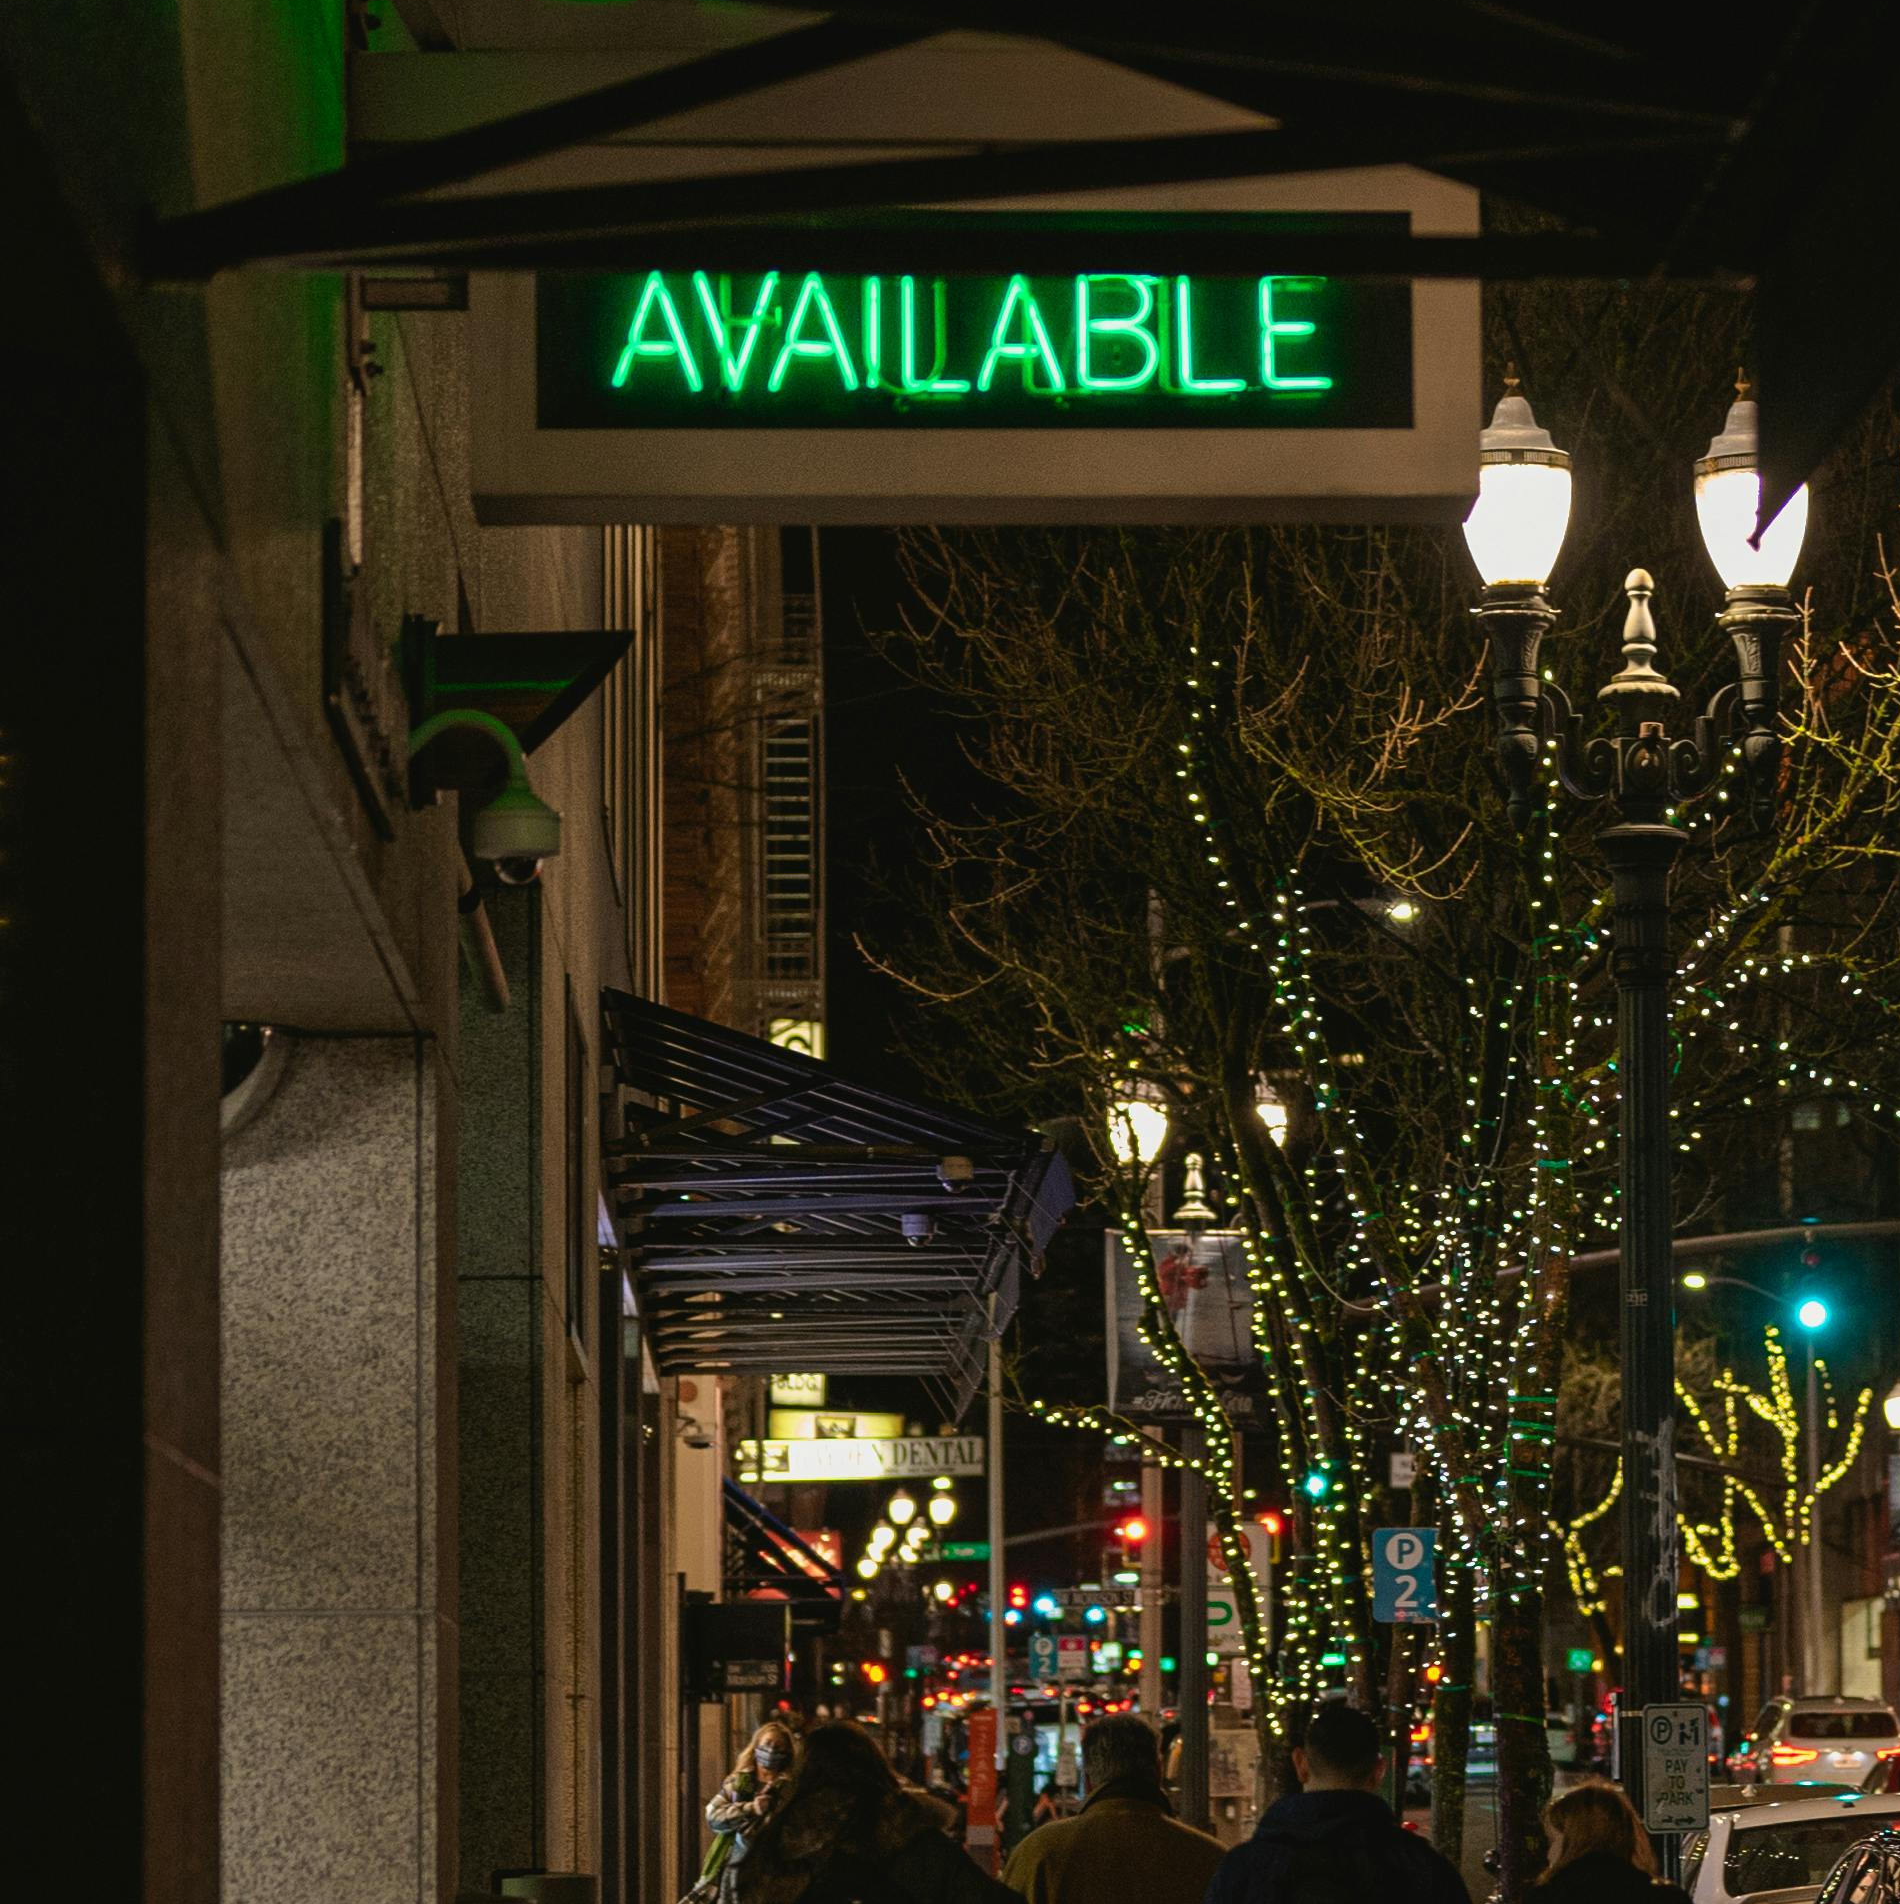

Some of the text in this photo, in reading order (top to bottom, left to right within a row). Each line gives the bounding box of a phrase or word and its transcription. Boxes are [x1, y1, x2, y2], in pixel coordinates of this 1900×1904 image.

[609, 269, 1335, 392] AVAILABLE
[893, 1440, 981, 1466] DENTAL
[1397, 1539, 1414, 1564] P
[1394, 1574, 1419, 1608] 2
[1664, 1759, 1688, 1774] PAY
[1668, 1775, 1686, 1790] TO
[1660, 1792, 1694, 1806] PARK
